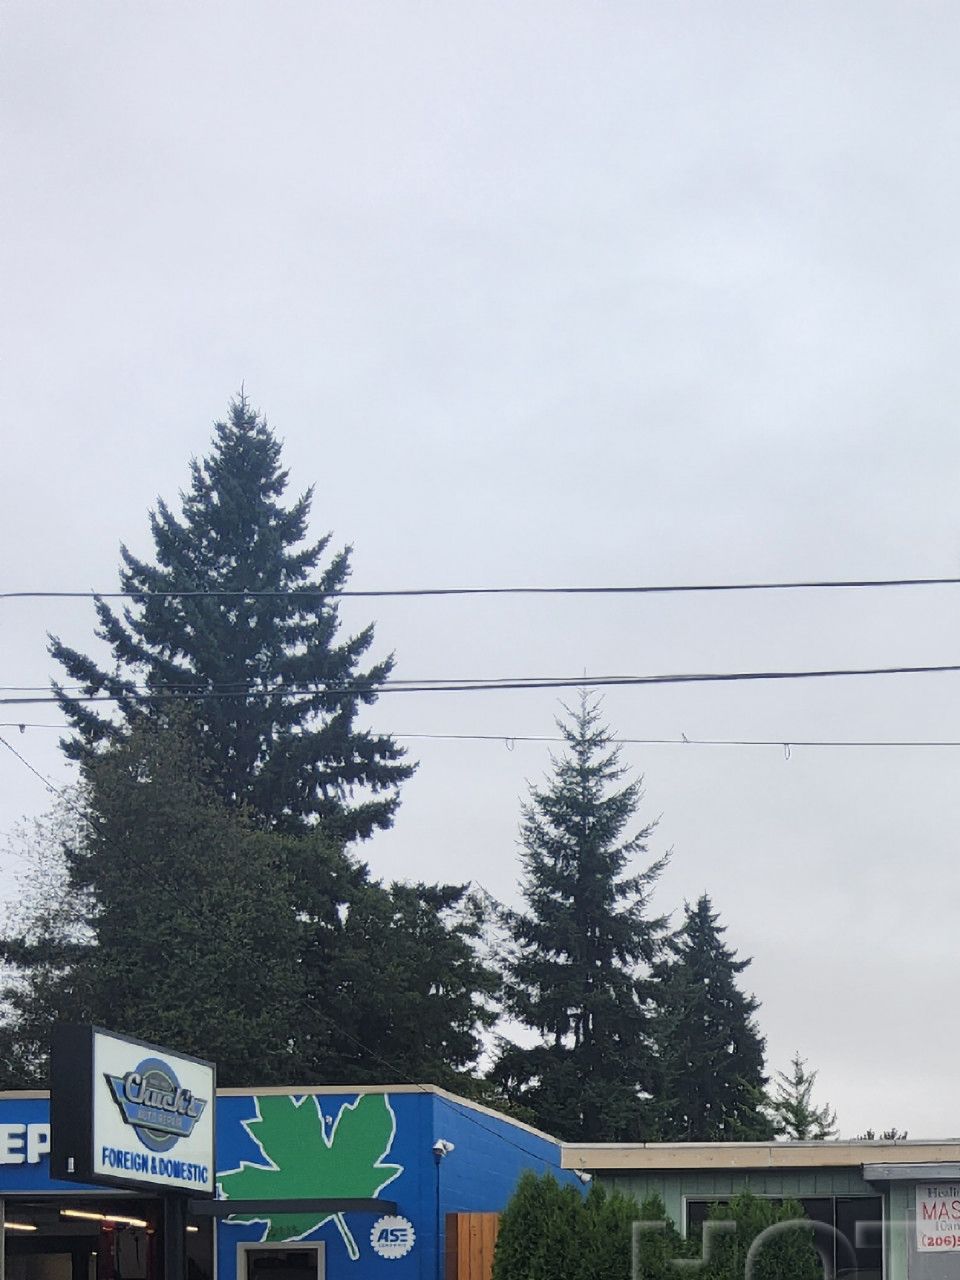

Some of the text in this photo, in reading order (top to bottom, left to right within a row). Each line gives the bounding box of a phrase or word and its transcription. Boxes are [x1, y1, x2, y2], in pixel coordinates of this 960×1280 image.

[123, 1071, 200, 1118] Chuck's
[102, 1146, 208, 1184] FOREIGN & DOMESTIC
[377, 1228, 408, 1243] ASE
